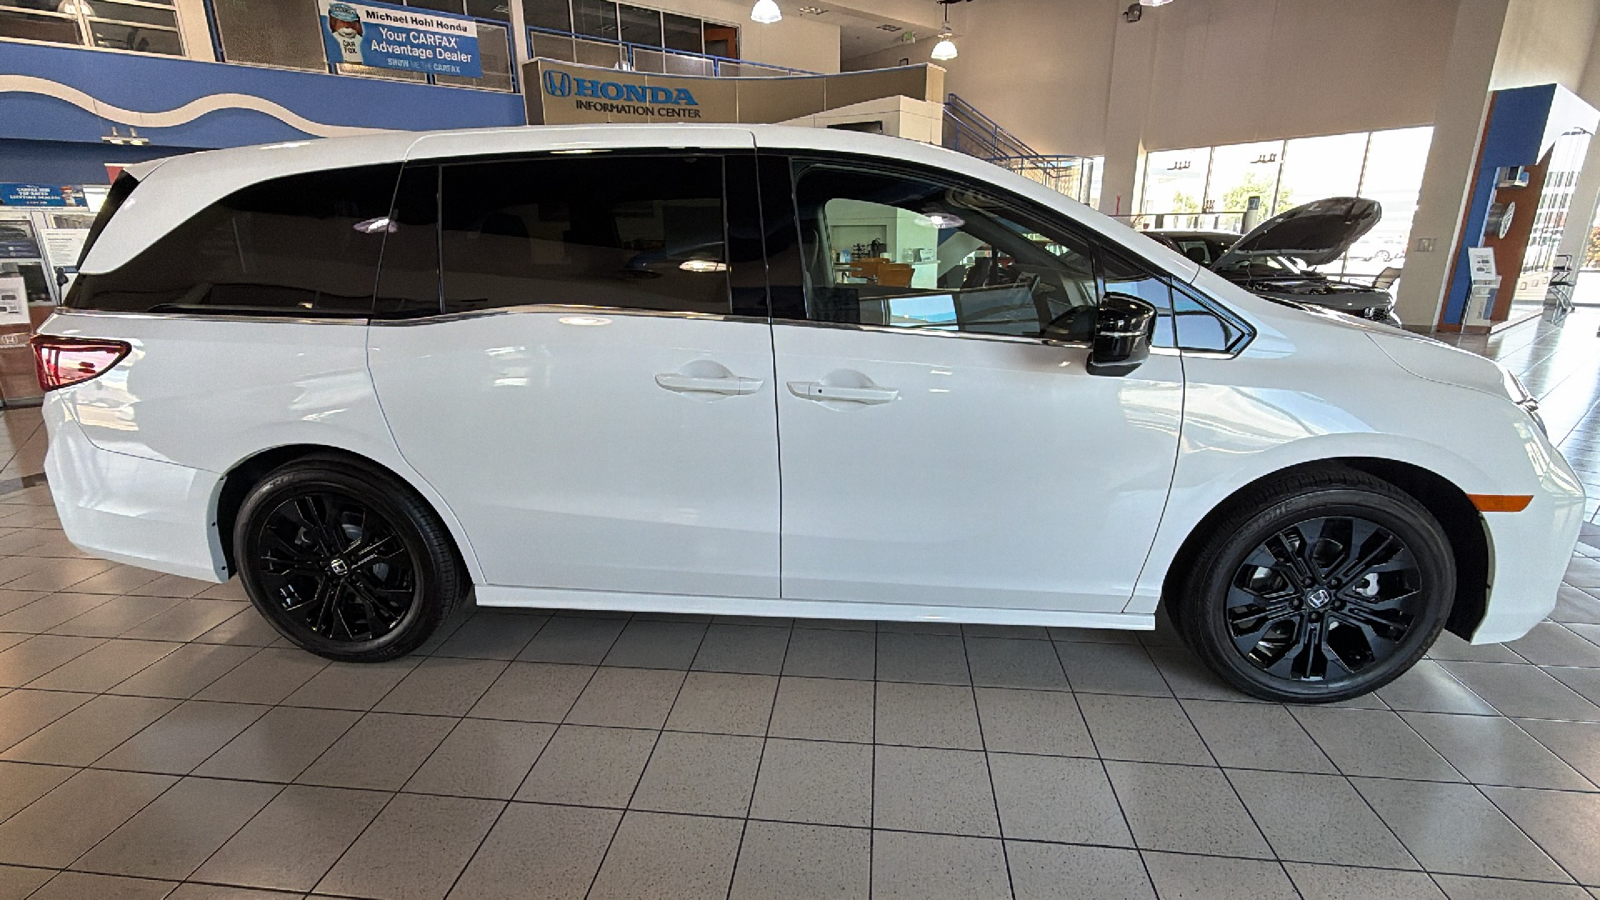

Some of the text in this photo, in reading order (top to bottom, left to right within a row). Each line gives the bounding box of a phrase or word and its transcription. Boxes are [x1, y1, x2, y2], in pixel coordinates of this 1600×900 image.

[365, 10, 468, 33] Michael Hohl Honda
[342, 39, 356, 47] CAR
[379, 26, 458, 49] Your CARFAX
[371, 39, 472, 63] Advantage Dealer
[387, 57, 410, 68] SHOW
[433, 63, 461, 74] CARFAX
[573, 77, 699, 106] HONDA
[575, 99, 702, 119] INFORMATION CENTER
